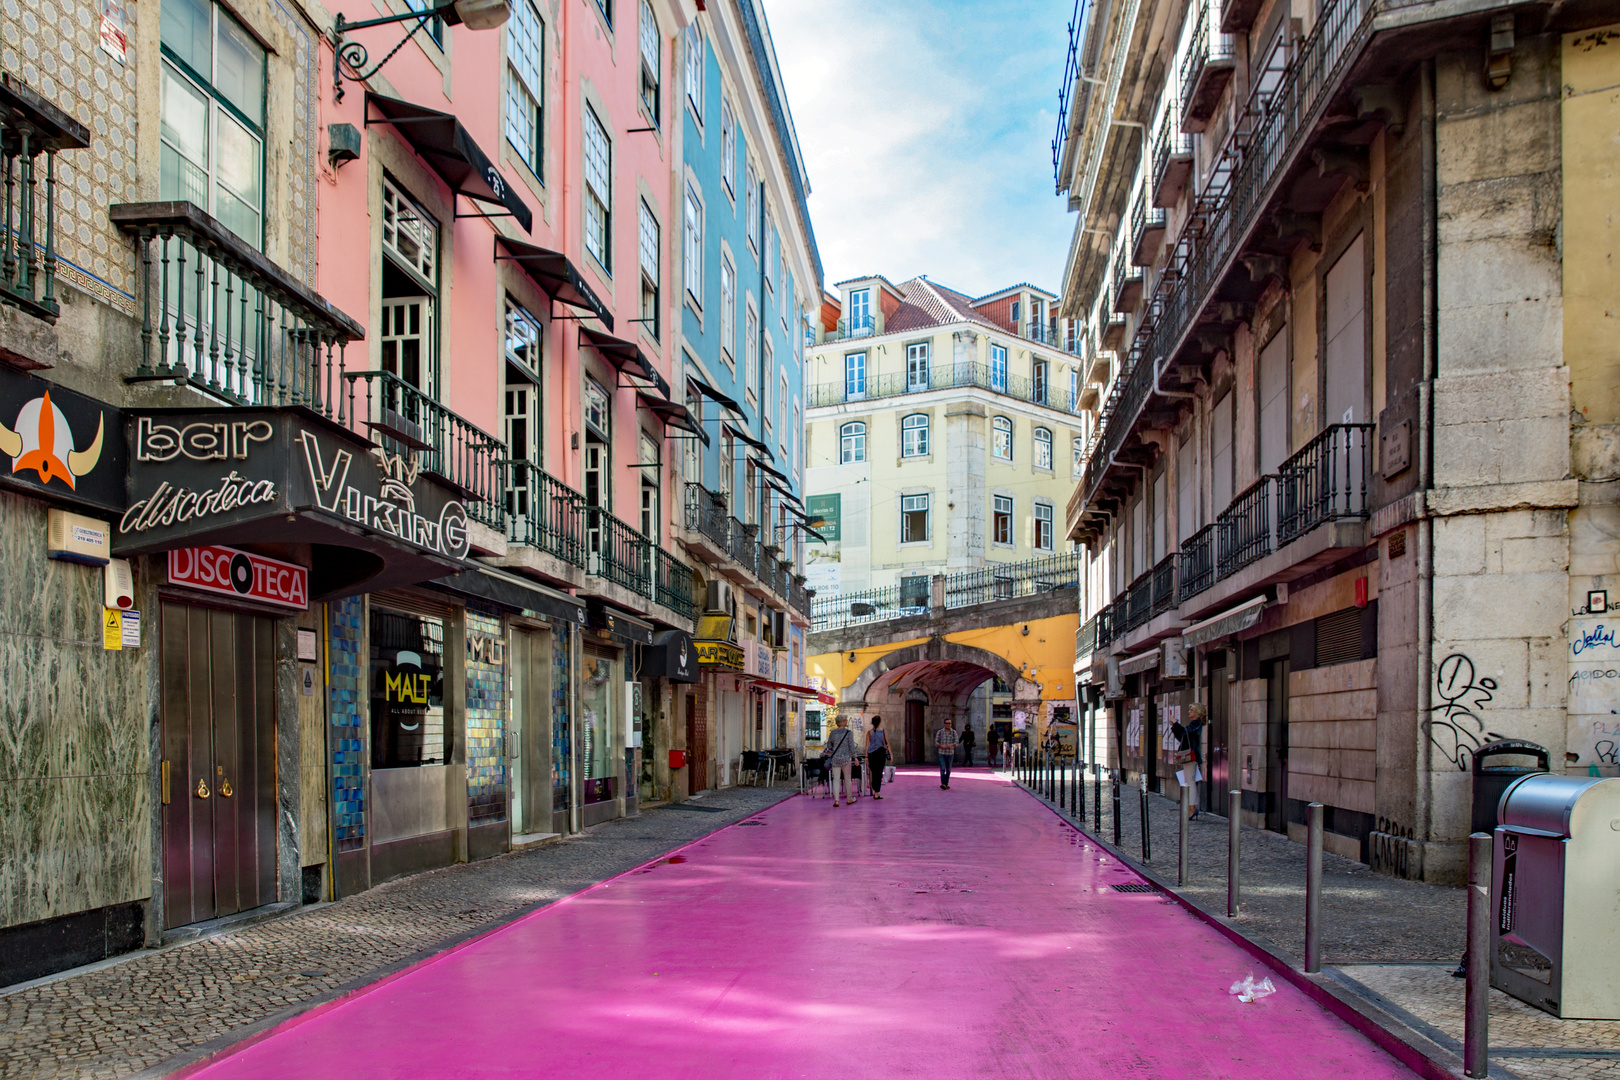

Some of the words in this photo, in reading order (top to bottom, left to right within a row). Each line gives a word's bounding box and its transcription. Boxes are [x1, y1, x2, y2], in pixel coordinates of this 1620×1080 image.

[137, 417, 273, 461] bar
[173, 547, 305, 604] DISCOTECA
[471, 635, 505, 665] MALT
[385, 670, 431, 704] MALT
